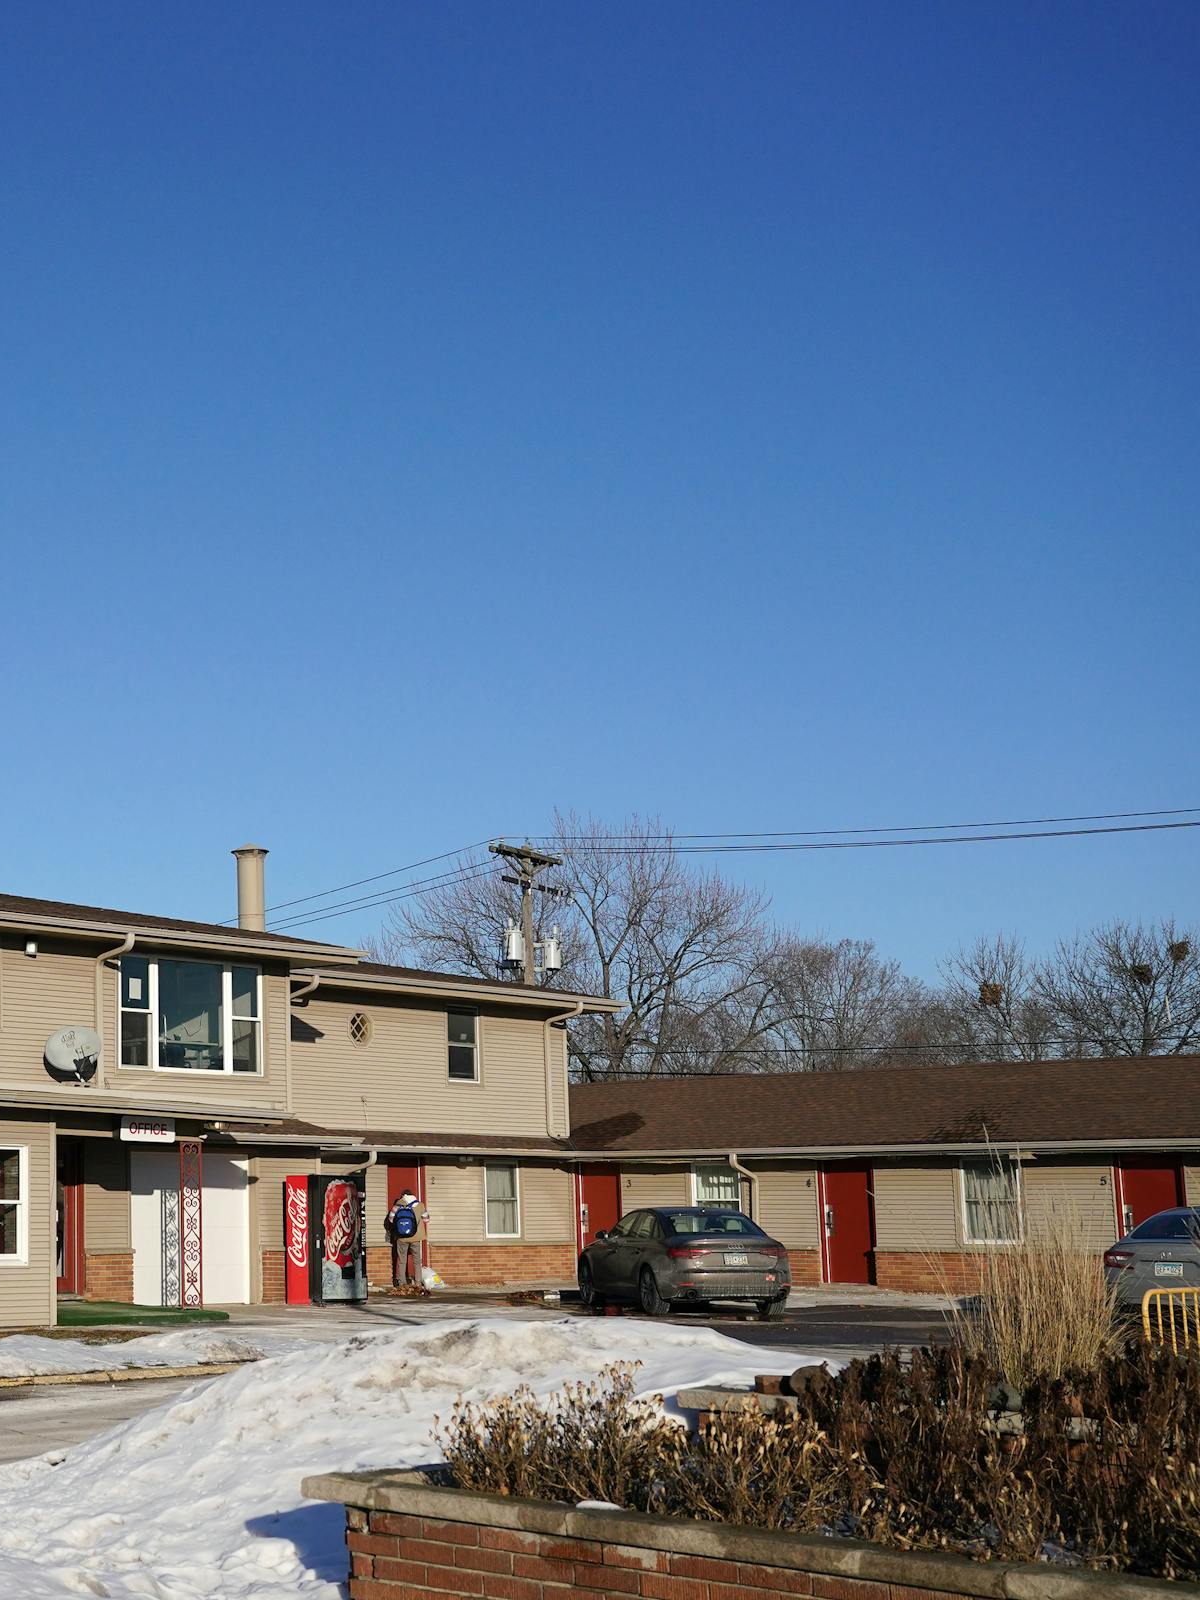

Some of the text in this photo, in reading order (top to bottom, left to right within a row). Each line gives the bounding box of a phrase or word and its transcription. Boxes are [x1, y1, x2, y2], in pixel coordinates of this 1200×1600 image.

[129, 1122, 167, 1135] OFFICE
[1099, 1176, 1107, 1186] 5
[287, 1183, 307, 1267] Coca-Cola
